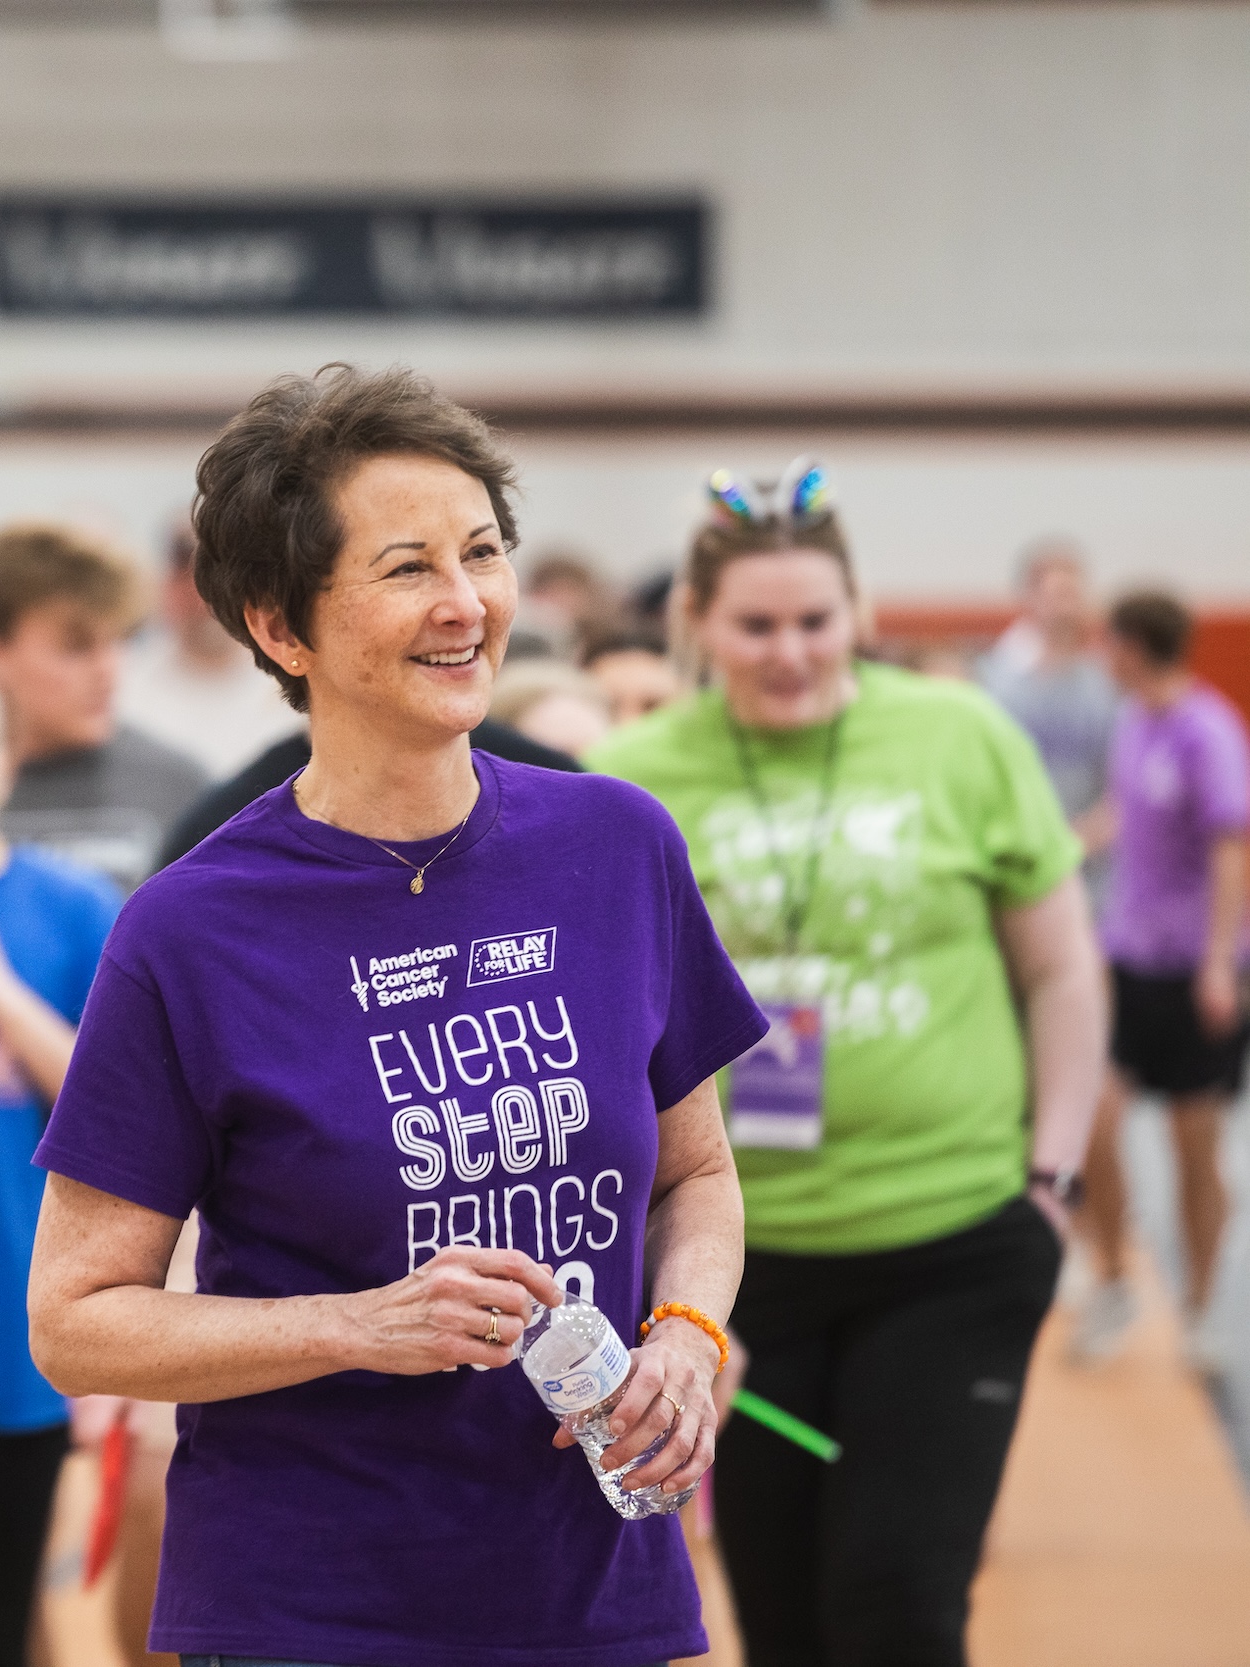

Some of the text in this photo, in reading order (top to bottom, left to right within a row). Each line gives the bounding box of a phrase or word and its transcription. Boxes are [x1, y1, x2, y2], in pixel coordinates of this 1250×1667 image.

[368, 943, 458, 976] American
[487, 934, 547, 960] RELAY
[484, 952, 547, 974] FOR LIFE
[371, 964, 440, 991] Cancer
[376, 979, 447, 1007] Society
